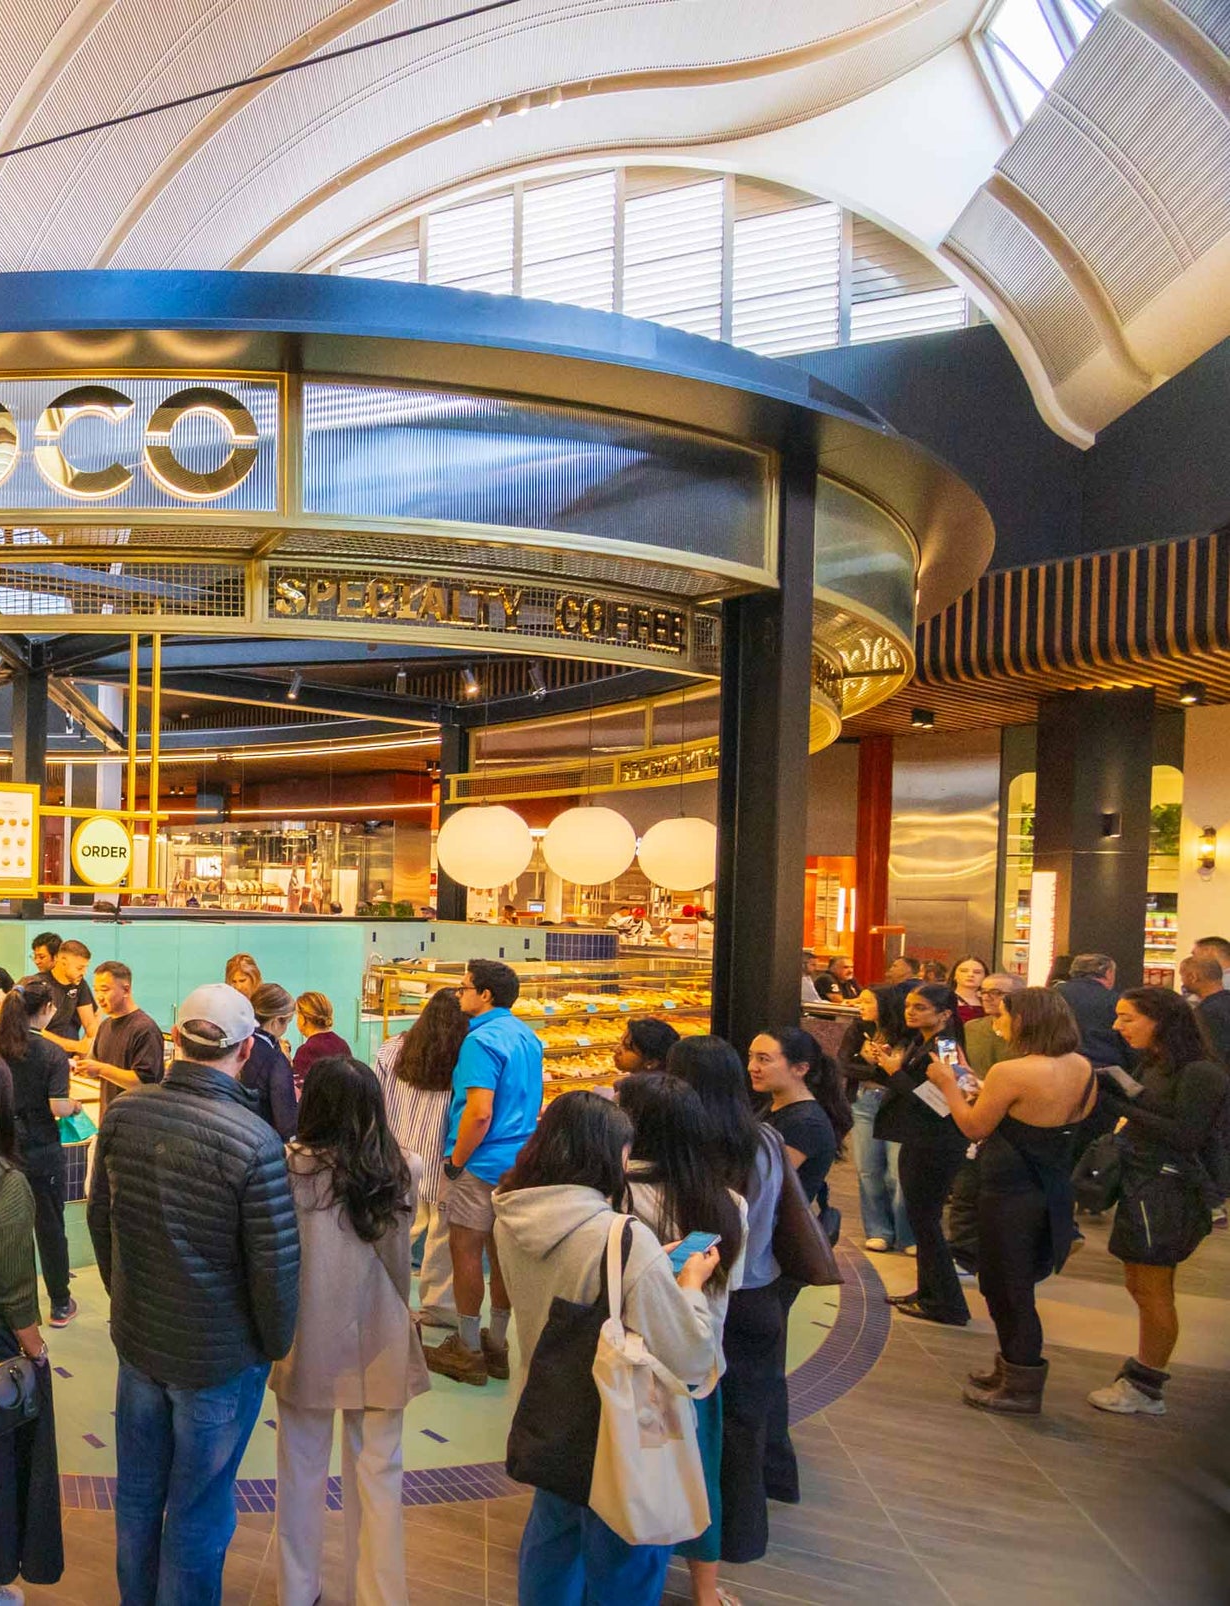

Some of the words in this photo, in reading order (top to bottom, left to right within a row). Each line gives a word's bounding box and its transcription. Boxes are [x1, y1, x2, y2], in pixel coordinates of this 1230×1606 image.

[276, 577, 523, 631] SPECIALTY
[555, 595, 688, 655] COFFEE
[81, 845, 127, 858] ORDER
